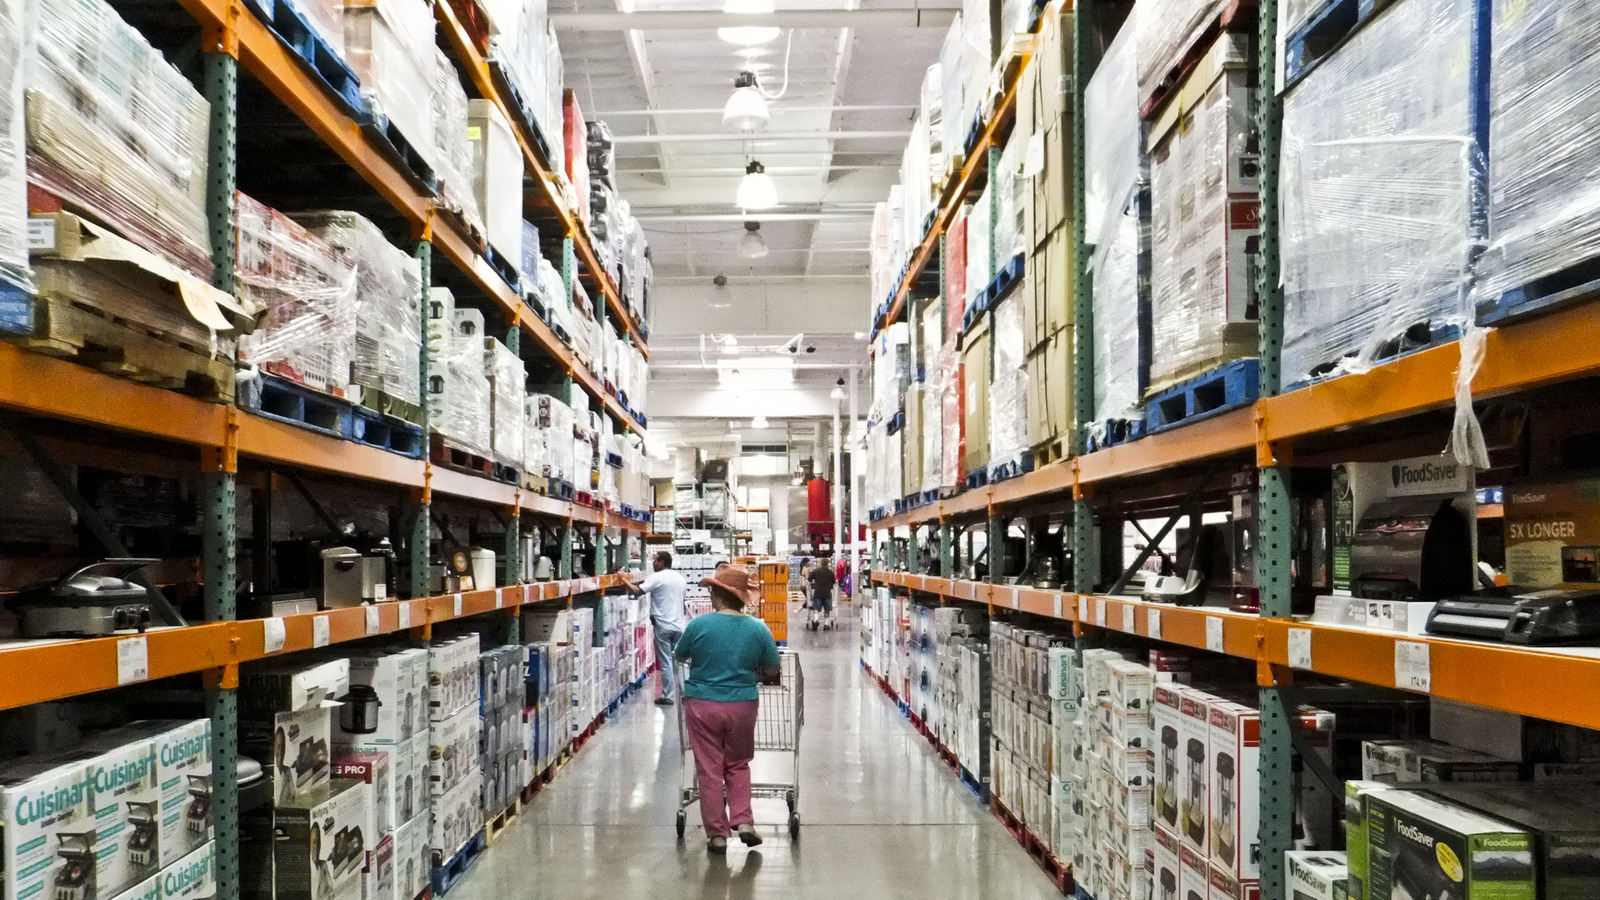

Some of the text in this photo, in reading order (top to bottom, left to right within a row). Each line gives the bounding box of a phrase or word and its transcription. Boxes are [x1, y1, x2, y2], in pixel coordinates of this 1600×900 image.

[1401, 463, 1458, 484] FoodSaver
[1512, 492, 1546, 504] FoodSaver
[1527, 521, 1576, 538] LONGER
[1059, 654, 1068, 697] Cuisinart
[160, 731, 211, 767] Cuisinart
[1371, 747, 1401, 766] FoodSaver
[95, 752, 157, 794] Cuisinart
[344, 765, 366, 774] PRO
[15, 776, 95, 826] Cuisinart
[1397, 819, 1434, 848] FoodSaver
[164, 847, 216, 897] Cuisinart
[1295, 861, 1327, 894] FoodSaver
